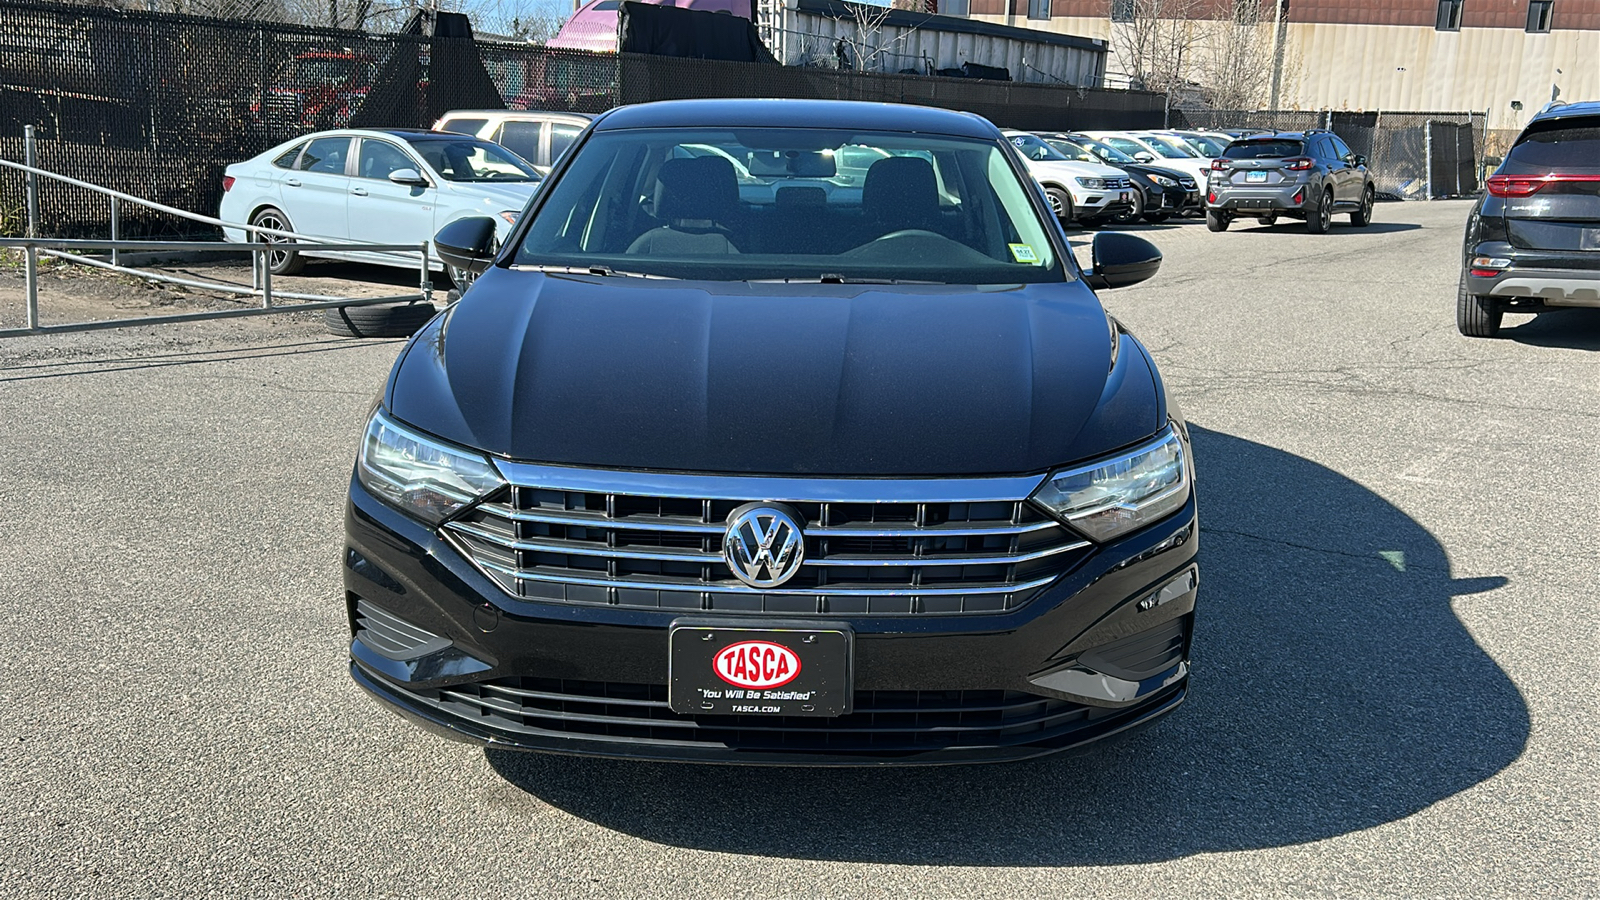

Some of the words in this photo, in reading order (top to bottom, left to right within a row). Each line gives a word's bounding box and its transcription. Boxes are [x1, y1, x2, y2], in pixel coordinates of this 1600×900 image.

[724, 646, 789, 682] TASCA
[725, 690, 744, 699] Will
[746, 690, 761, 699] Be
[732, 705, 780, 713] TASCA.COM
